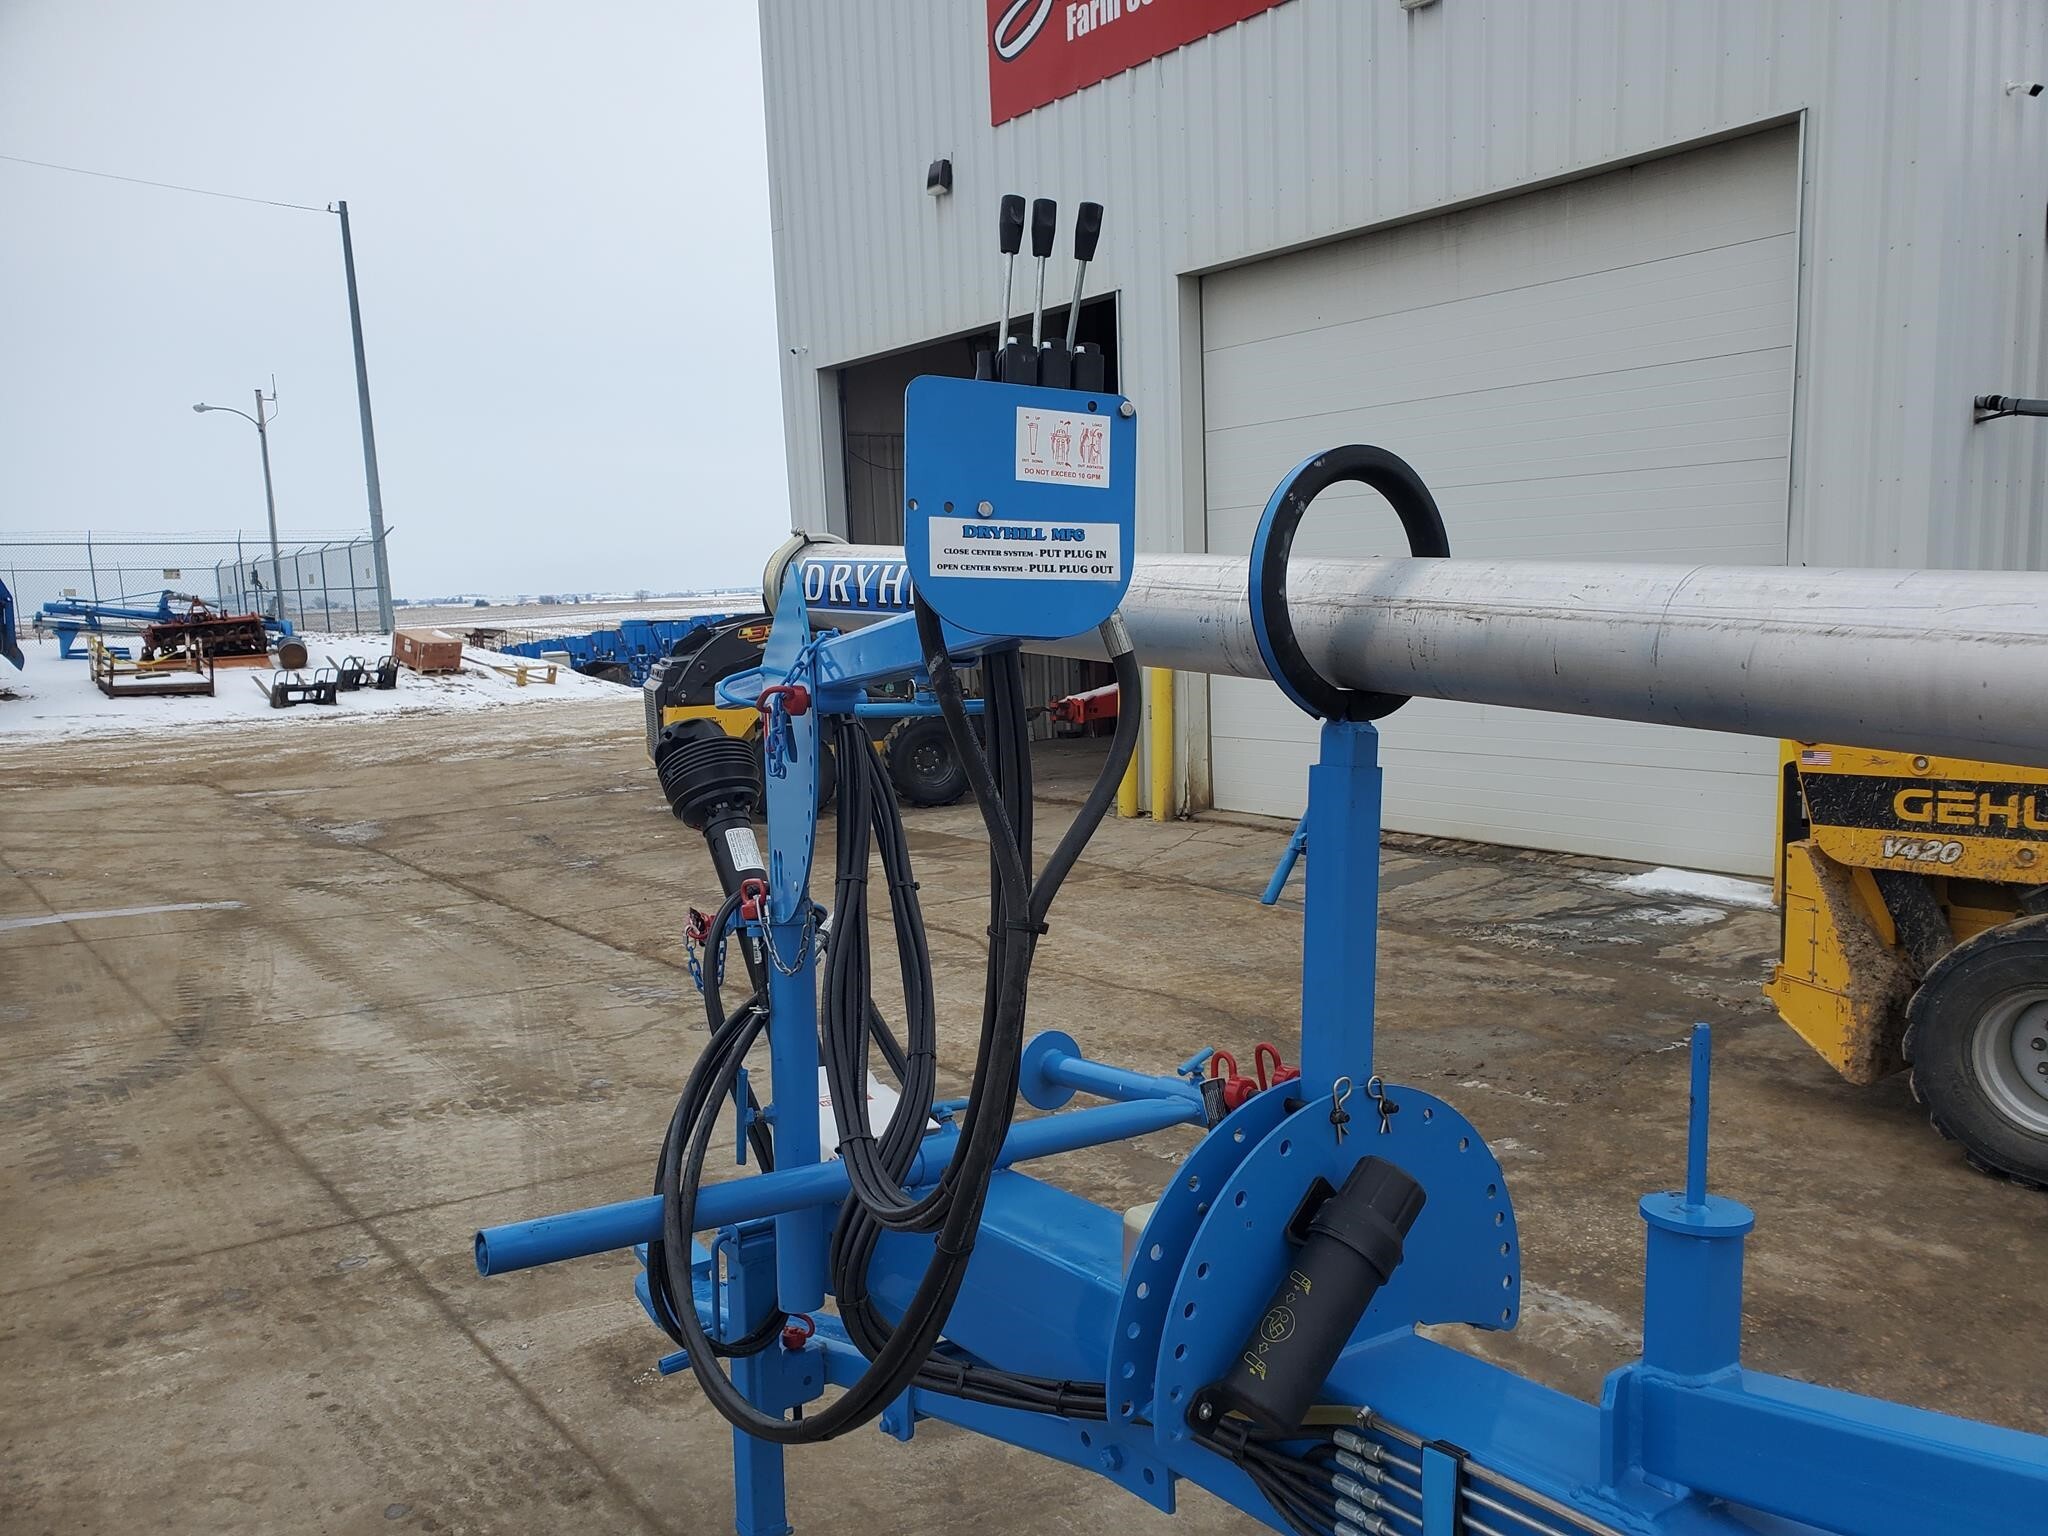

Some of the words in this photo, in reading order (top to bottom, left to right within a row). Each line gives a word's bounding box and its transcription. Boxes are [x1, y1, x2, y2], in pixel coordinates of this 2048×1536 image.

[1066, 0, 1121, 42] Farm
[1024, 467, 1034, 475] DO
[1036, 468, 1049, 476] NOT
[1051, 469, 1077, 478] EXCEED
[1078, 471, 1085, 479] 10
[1086, 472, 1102, 480] GPM
[962, 524, 1047, 541] DRYHILL
[1051, 527, 1086, 542] MFG
[943, 547, 970, 556] CLOSE
[971, 549, 1002, 557] CENTER
[1003, 550, 1034, 558] SYSTEM
[1039, 549, 1062, 559] PUT
[1064, 550, 1094, 559] PLUG
[1095, 550, 1107, 559] IN
[936, 563, 959, 571] OPEN
[960, 564, 991, 572] CENTER
[992, 565, 1023, 573] SYSTEM
[1028, 564, 1057, 573] PULL
[1058, 565, 1089, 574] PLUG
[1090, 565, 1114, 574] OUT
[1882, 835, 1965, 865] V420
